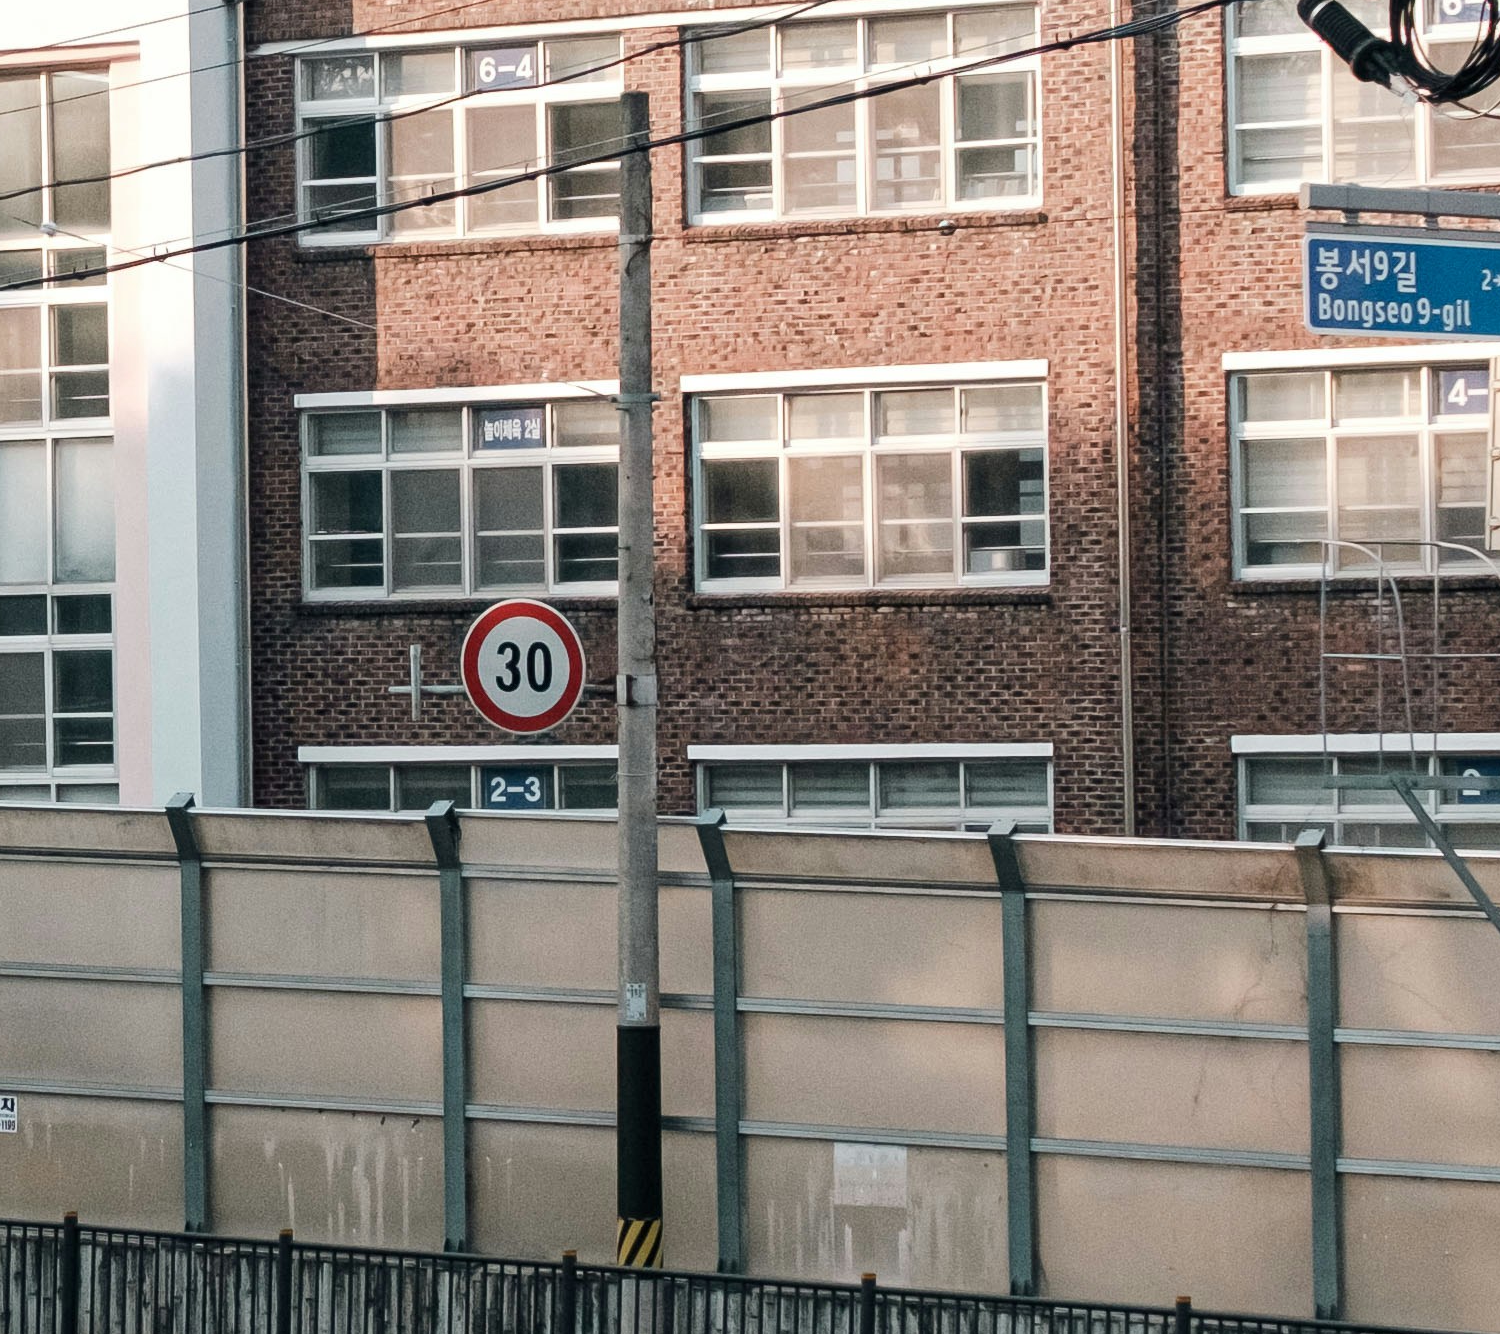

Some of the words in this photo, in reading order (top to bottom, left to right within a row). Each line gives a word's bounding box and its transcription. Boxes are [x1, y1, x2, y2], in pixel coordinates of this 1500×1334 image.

[480, 54, 533, 83] 6-4
[1315, 247, 1417, 293] 봉서9길
[1318, 293, 1413, 328] Bongseo
[1417, 297, 1472, 331] 9-gil
[495, 641, 553, 693] 30
[490, 776, 541, 803] 2-3
